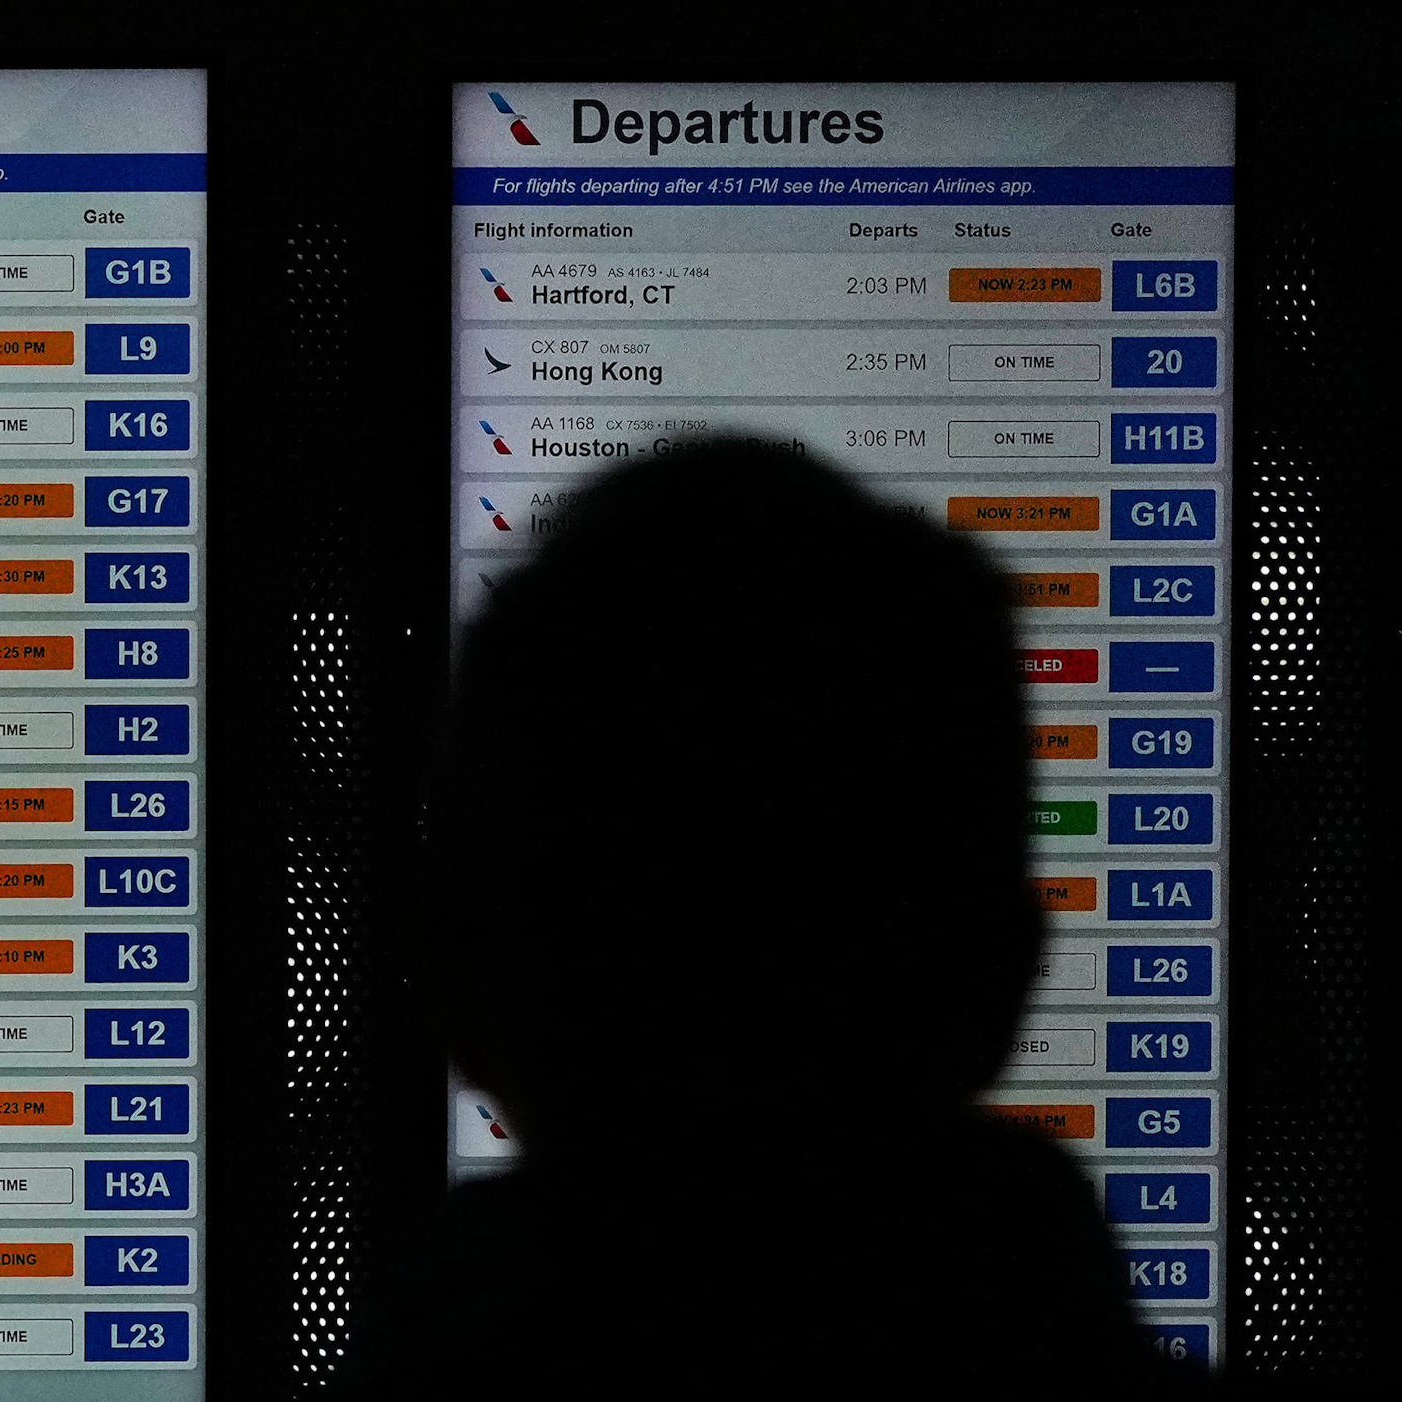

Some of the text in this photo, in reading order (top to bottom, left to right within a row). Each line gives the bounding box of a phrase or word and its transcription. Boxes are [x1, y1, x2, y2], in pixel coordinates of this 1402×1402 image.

[572, 98, 885, 156] Departures
[105, 259, 172, 285] G1B
[1136, 272, 1196, 298] L6B
[532, 284, 676, 306] Hartford, CT
[120, 335, 157, 361] L9
[531, 339, 590, 355] CX 807
[599, 343, 651, 355] OM 5807
[532, 361, 663, 386] Hong Kong
[846, 352, 927, 371] 2:35 PM
[1146, 349, 1183, 374] 20
[109, 412, 168, 438] K16
[107, 488, 169, 514] G17
[1130, 501, 1198, 527] G1A
[118, 640, 159, 666] H8
[118, 716, 159, 742] H2
[1131, 730, 1192, 755] G19
[111, 792, 166, 818] L26
[1134, 805, 1190, 832] L20
[1131, 881, 1192, 907] L1A
[118, 944, 158, 970] K3
[1131, 1033, 1190, 1059] K19
[1137, 1109, 1181, 1135] G5
[106, 1171, 171, 1197] H3A
[118, 1247, 158, 1273] K2
